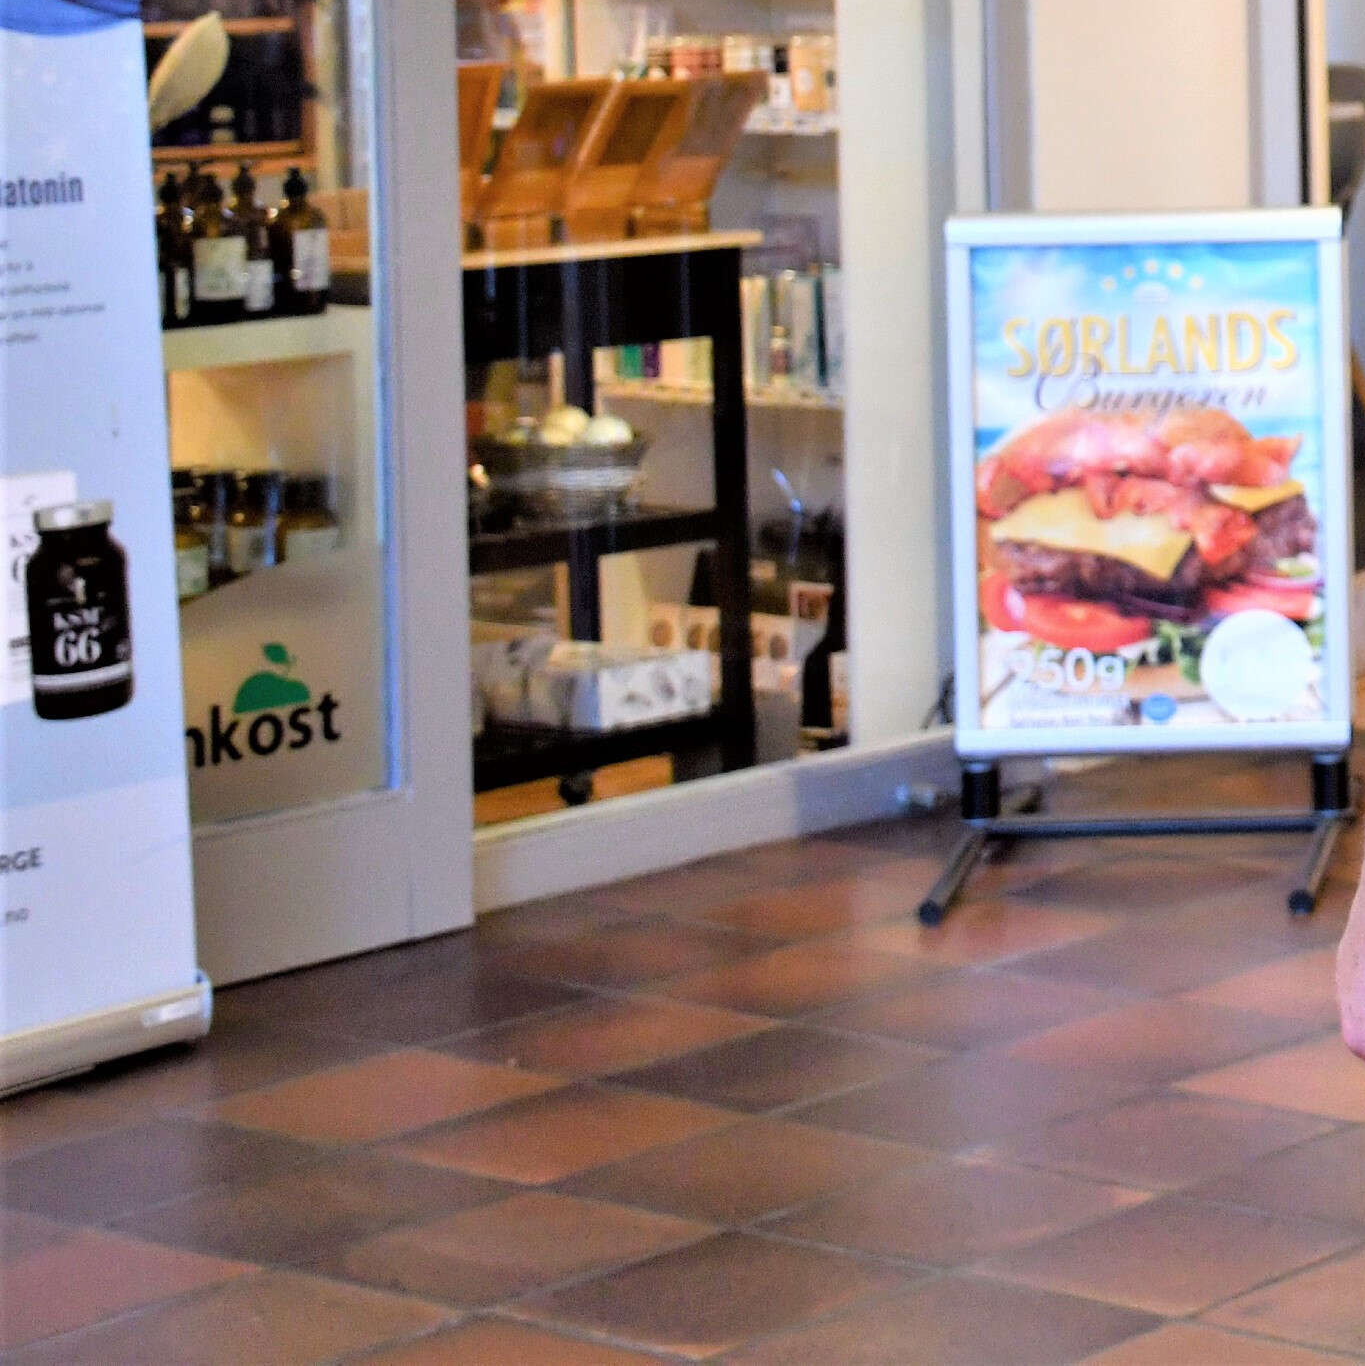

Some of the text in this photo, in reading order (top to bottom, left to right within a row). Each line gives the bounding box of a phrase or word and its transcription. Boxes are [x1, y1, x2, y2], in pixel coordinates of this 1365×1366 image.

[0, 171, 84, 208] atonin
[1003, 310, 1298, 378] SØRLANDS
[54, 629, 101, 667] 66
